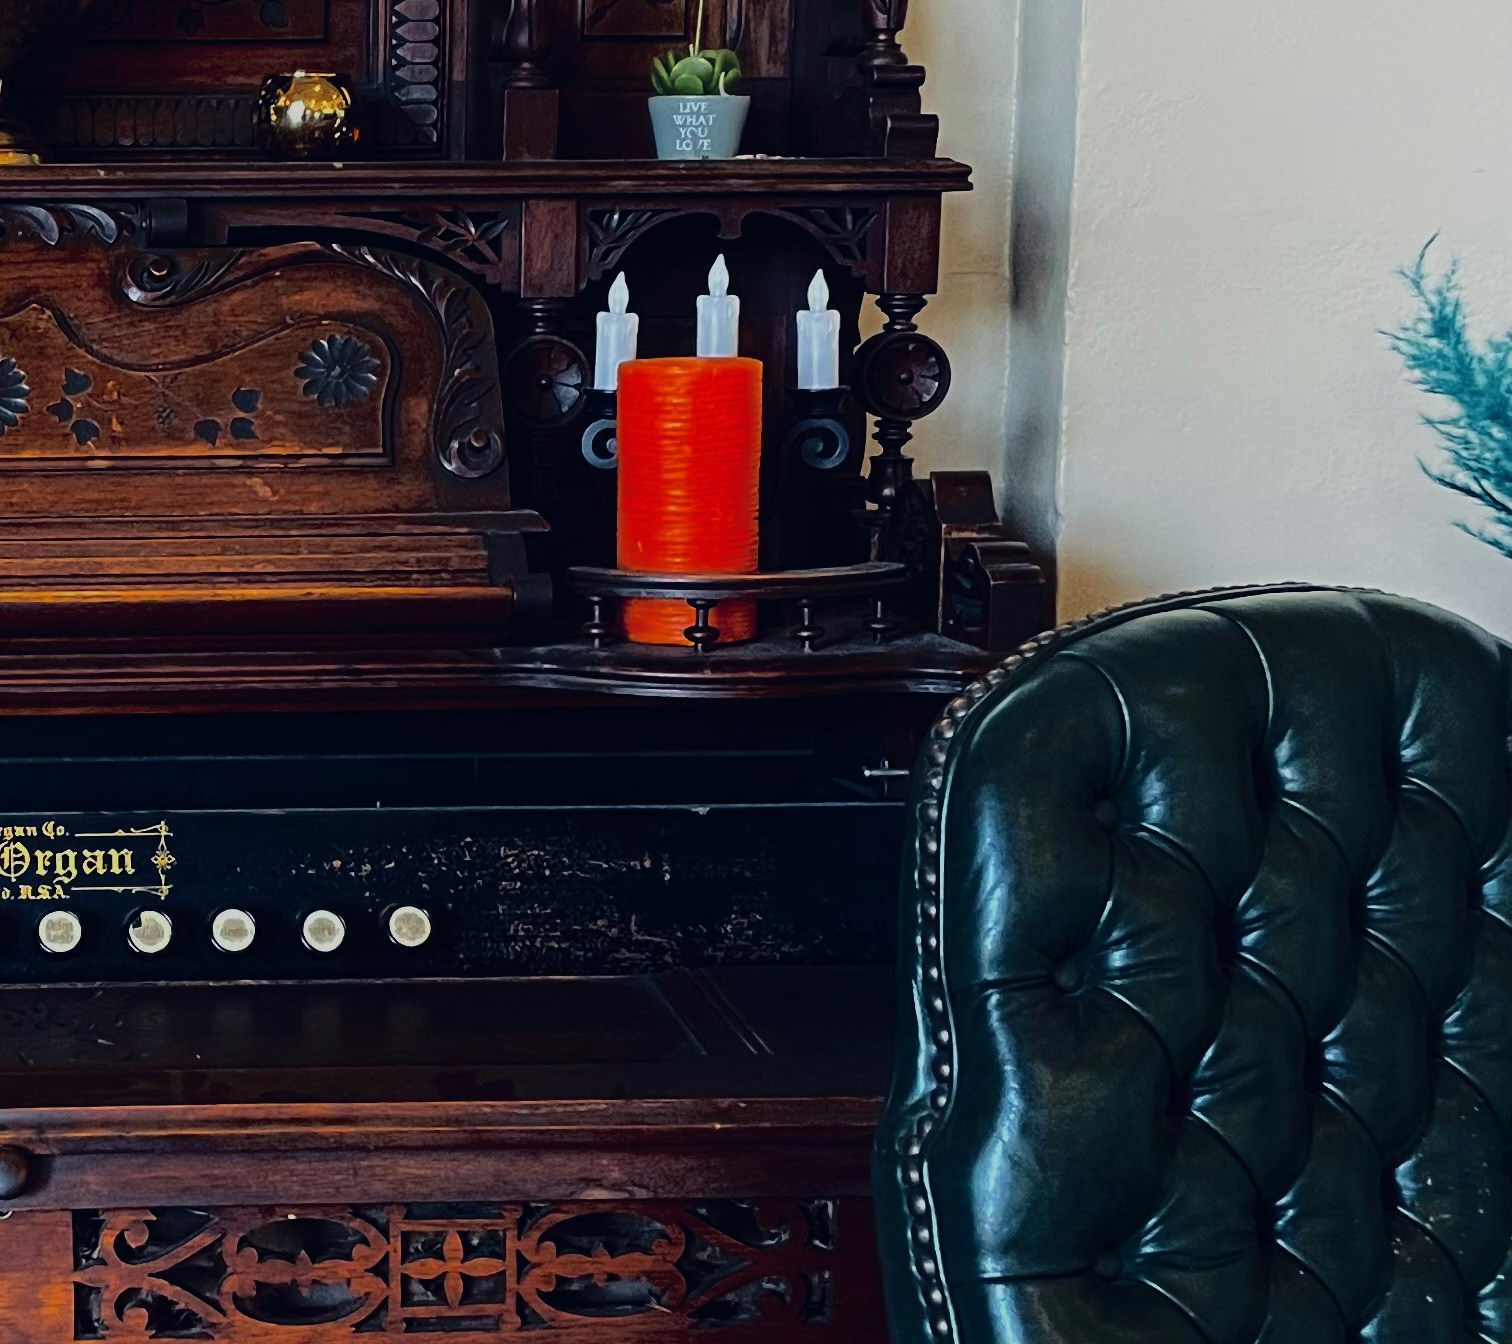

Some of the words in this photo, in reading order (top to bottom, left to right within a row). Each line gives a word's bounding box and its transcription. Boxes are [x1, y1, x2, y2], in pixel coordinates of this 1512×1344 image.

[679, 102, 709, 113] LIVE
[673, 114, 716, 126] WHAT
[678, 127, 708, 138] YOU
[41, 820, 71, 840] Co.
